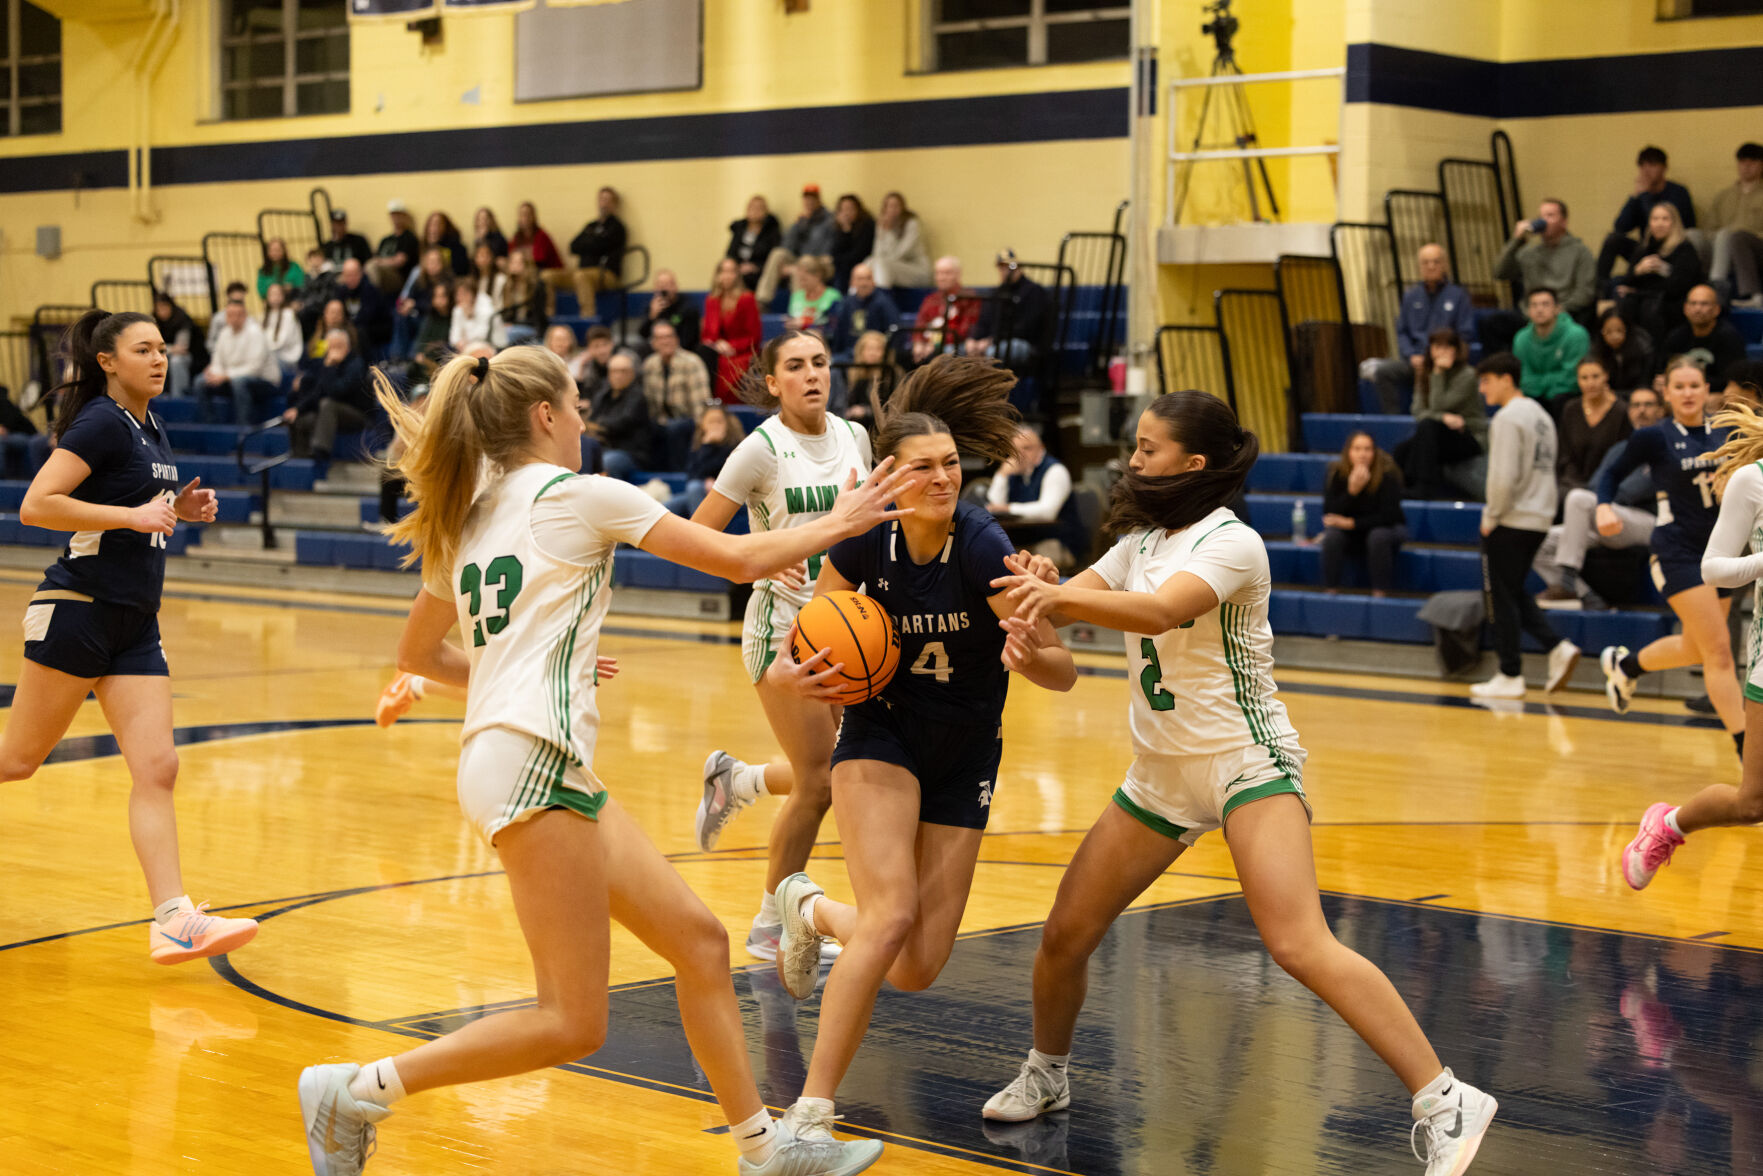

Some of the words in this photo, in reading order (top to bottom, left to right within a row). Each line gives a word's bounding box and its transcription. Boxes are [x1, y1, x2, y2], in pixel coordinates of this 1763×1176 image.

[151, 462, 178, 481] SPARTAN
[460, 555, 523, 648] 23
[891, 611, 970, 634] ARTANS
[910, 641, 953, 683] 4
[1140, 637, 1175, 711] 2
